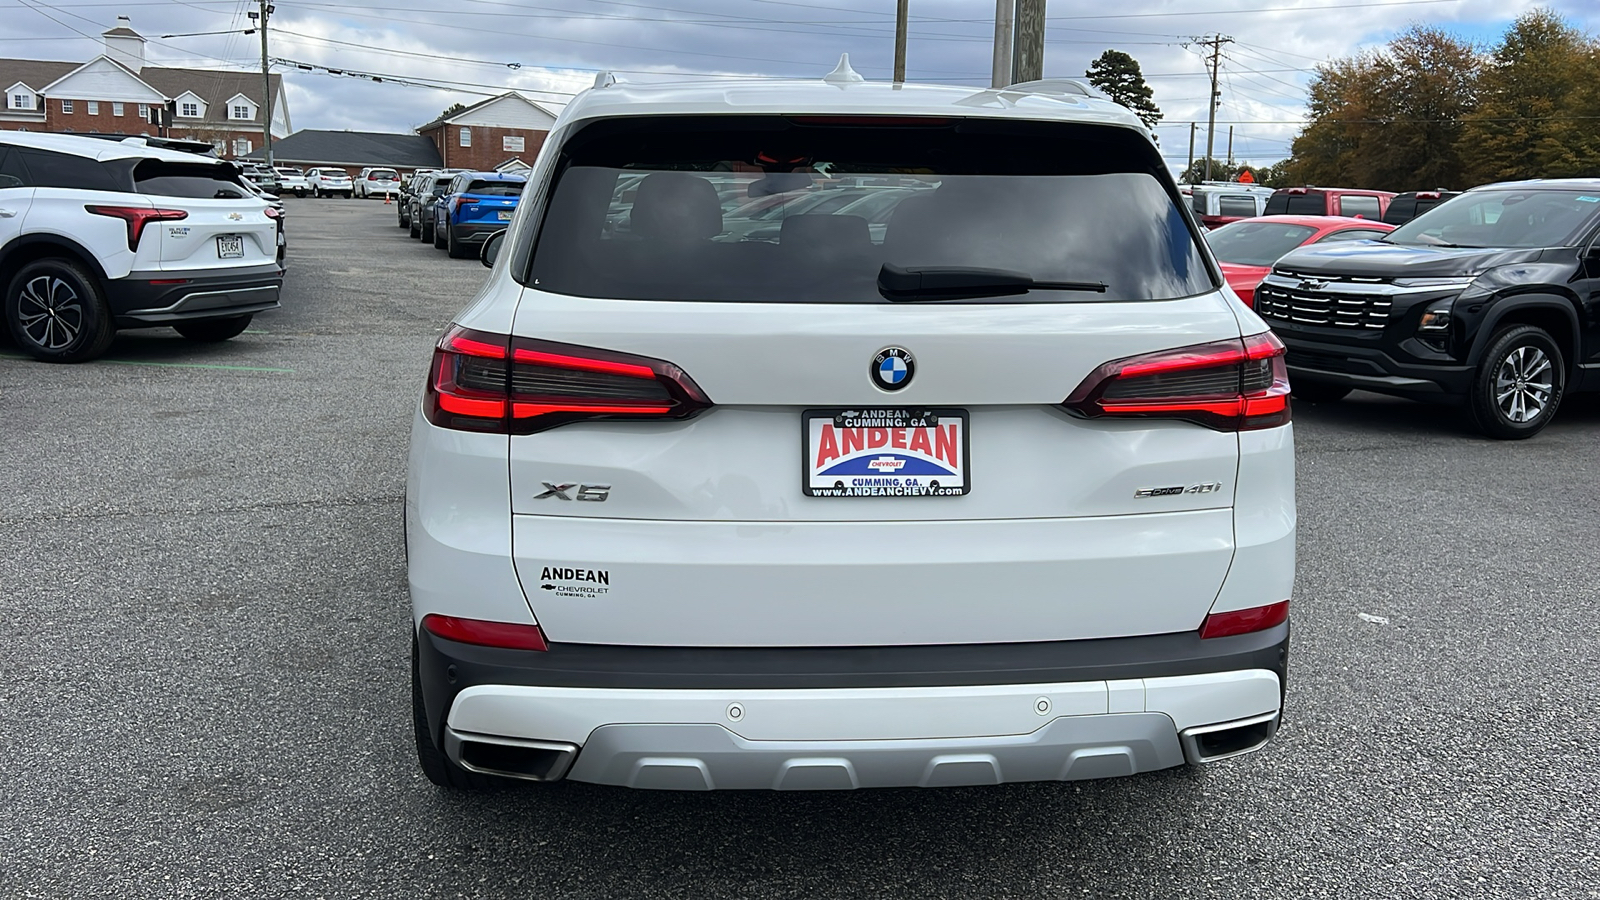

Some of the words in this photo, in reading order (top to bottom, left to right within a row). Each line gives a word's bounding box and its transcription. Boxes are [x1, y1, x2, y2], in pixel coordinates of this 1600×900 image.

[875, 349, 912, 364] BMW
[861, 410, 910, 418] ANDEAN
[845, 418, 907, 428] CUMMING,
[910, 418, 927, 427] GA
[816, 424, 958, 469] ANDEAN
[851, 478, 903, 488] CUMMING,
[532, 480, 612, 502] X5
[812, 487, 963, 497] www.ANDEANCHEVY.com
[540, 567, 610, 586] ANDEAN
[557, 585, 609, 594] CHEVROLET
